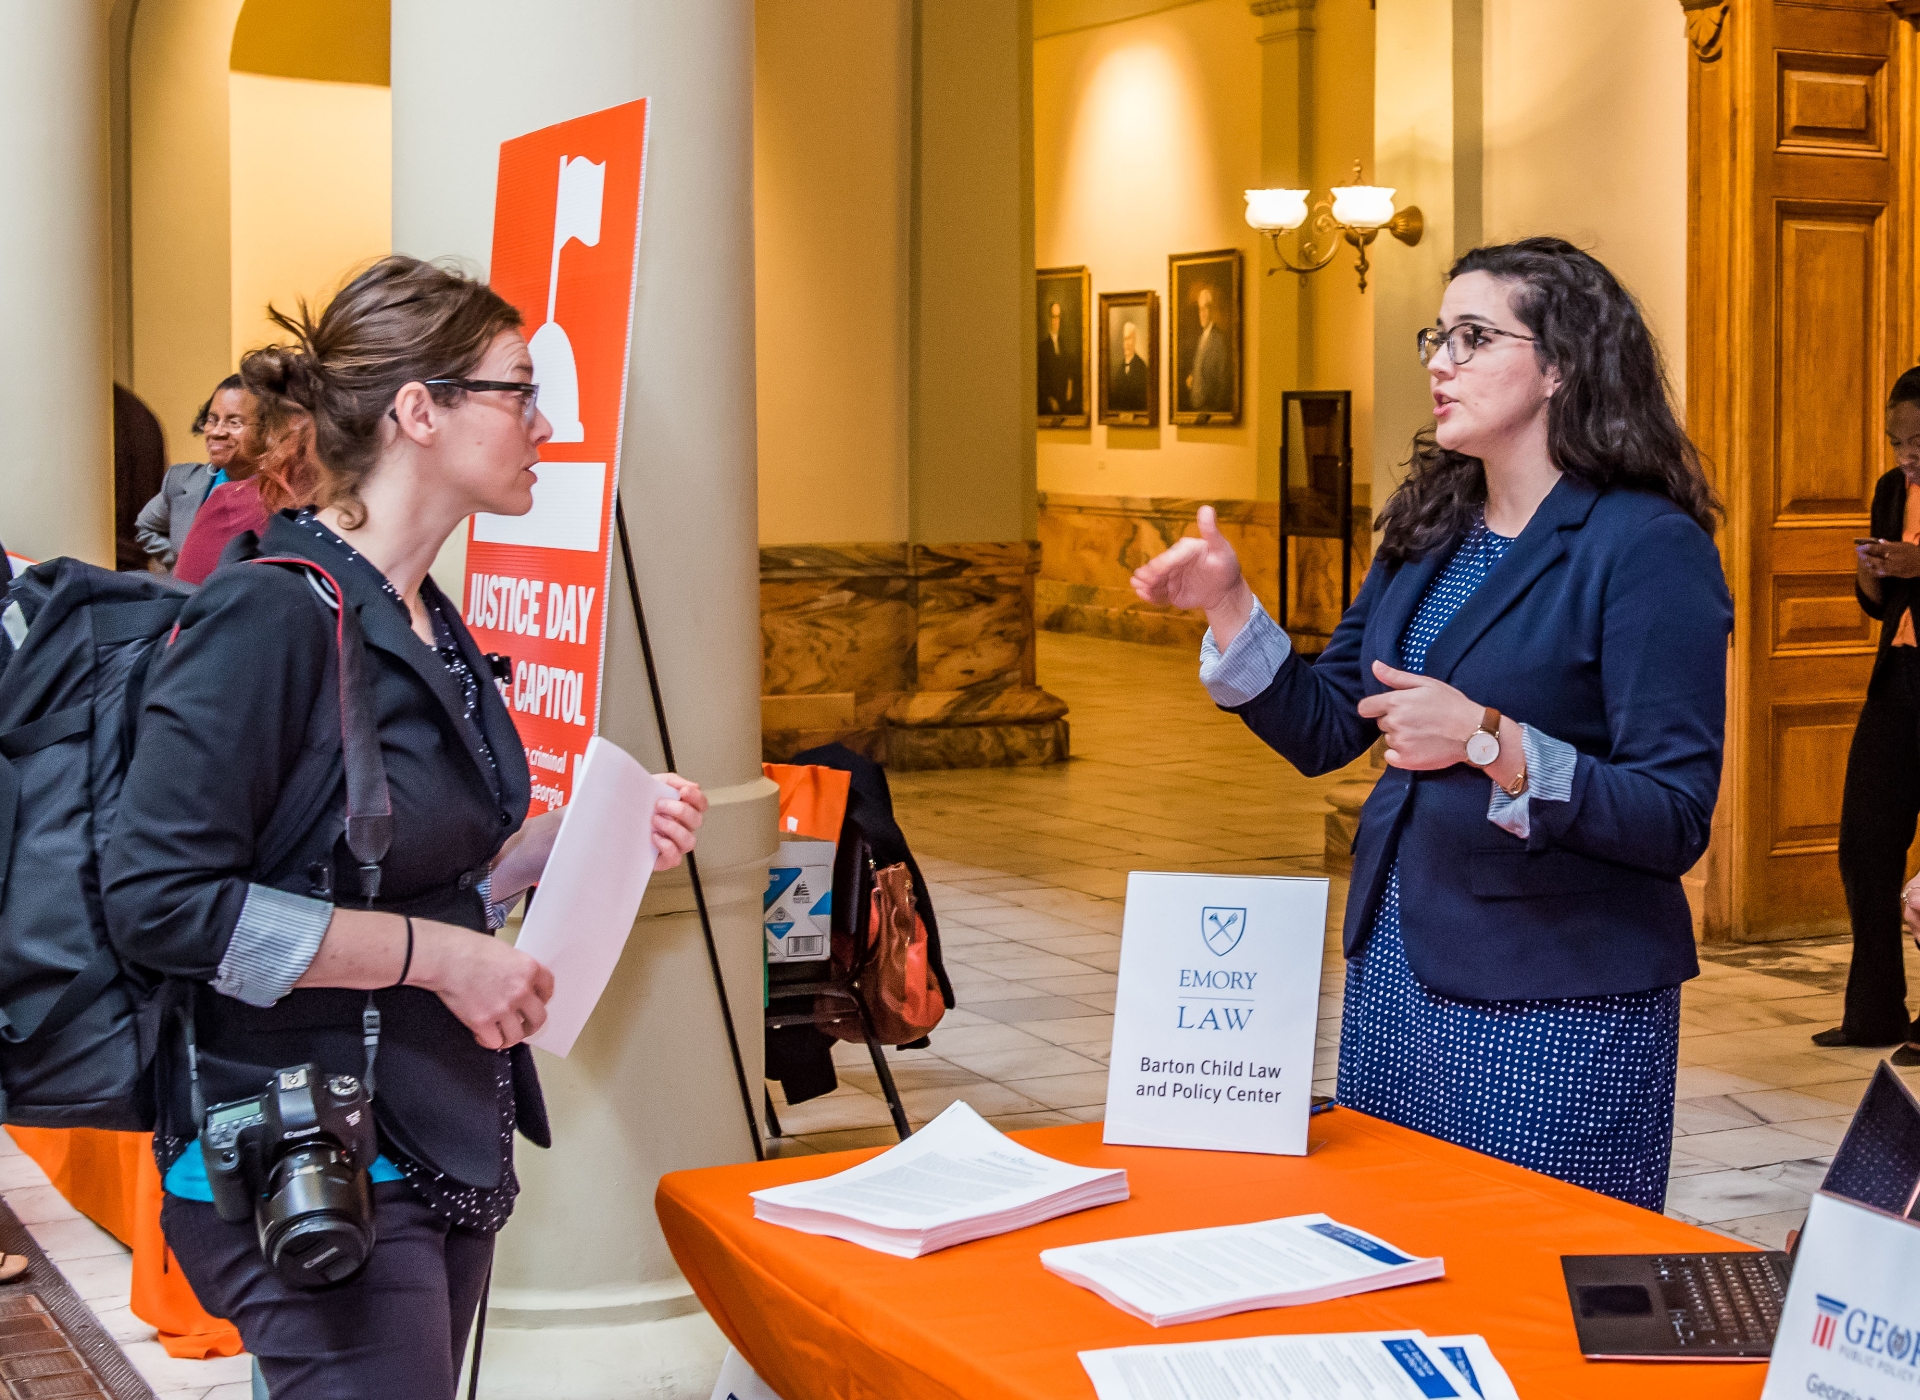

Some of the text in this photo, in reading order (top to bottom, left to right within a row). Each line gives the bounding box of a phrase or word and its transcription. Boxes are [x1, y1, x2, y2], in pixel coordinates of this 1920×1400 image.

[466, 572, 596, 645] JUSTICE DAY
[514, 660, 586, 726] CAPITOL
[529, 745, 568, 775] criminal
[1179, 969, 1257, 990] EMORY
[1176, 1005, 1253, 1031] LAW
[1140, 1056, 1281, 1079] Barton Child Law
[1136, 1081, 1282, 1104] and Policy Center
